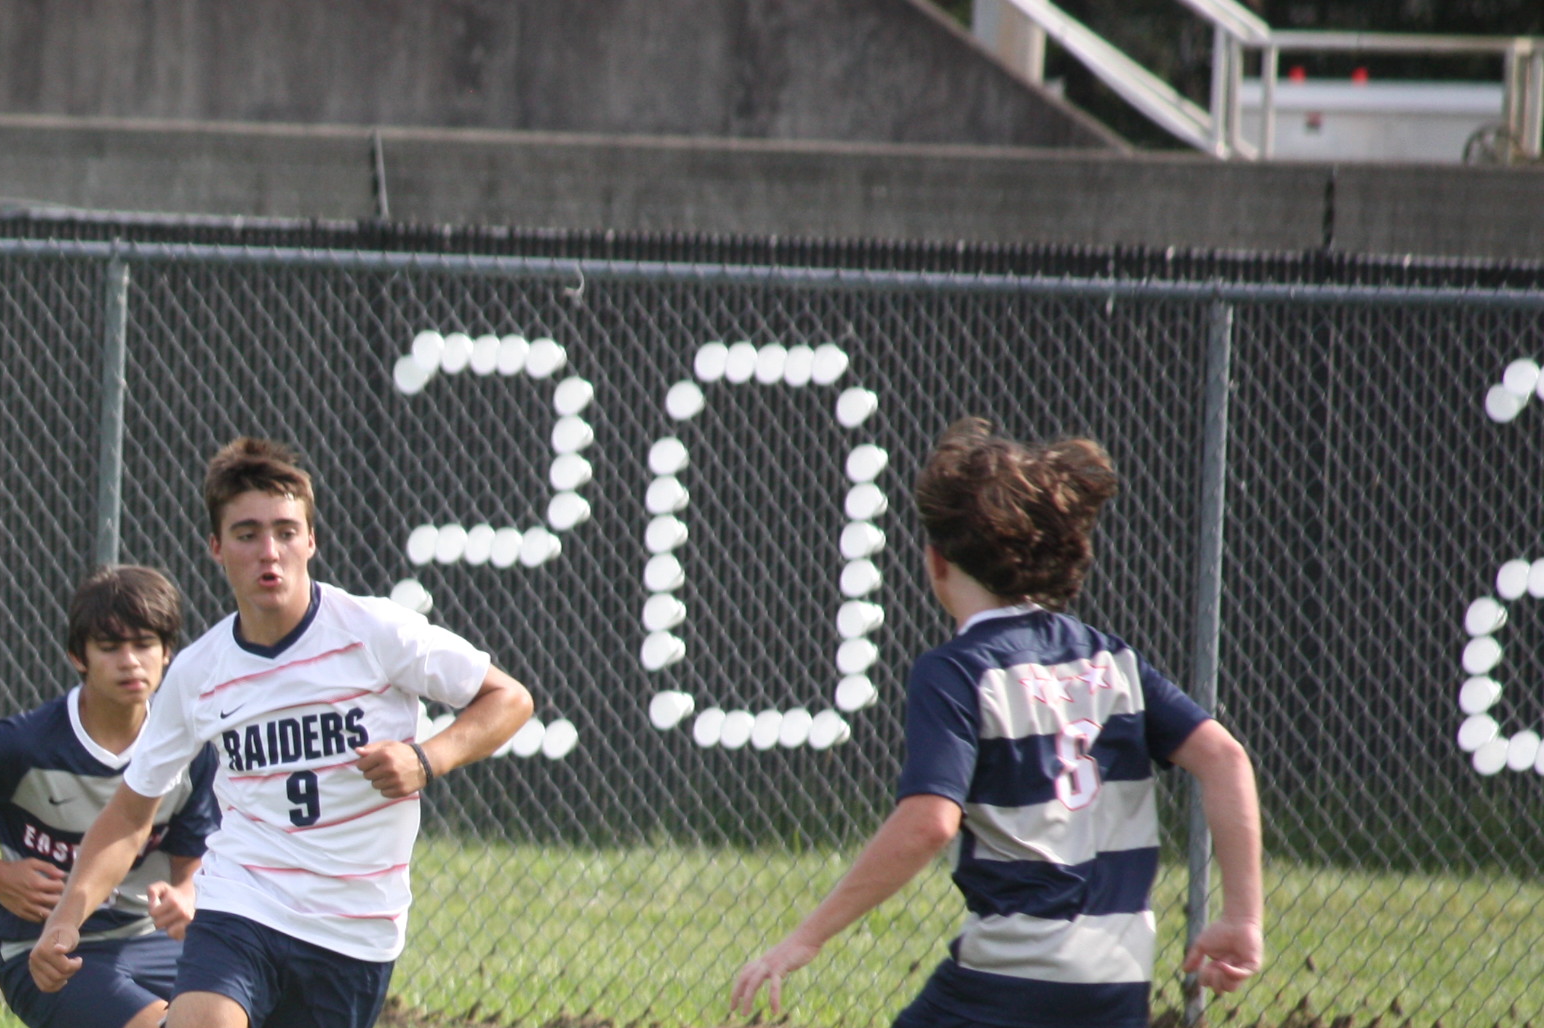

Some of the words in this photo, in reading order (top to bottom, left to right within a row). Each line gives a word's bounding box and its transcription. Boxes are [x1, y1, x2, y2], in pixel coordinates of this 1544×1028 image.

[378, 330, 889, 762] 20
[221, 706, 370, 772] RAIDERS
[286, 769, 321, 828] 9
